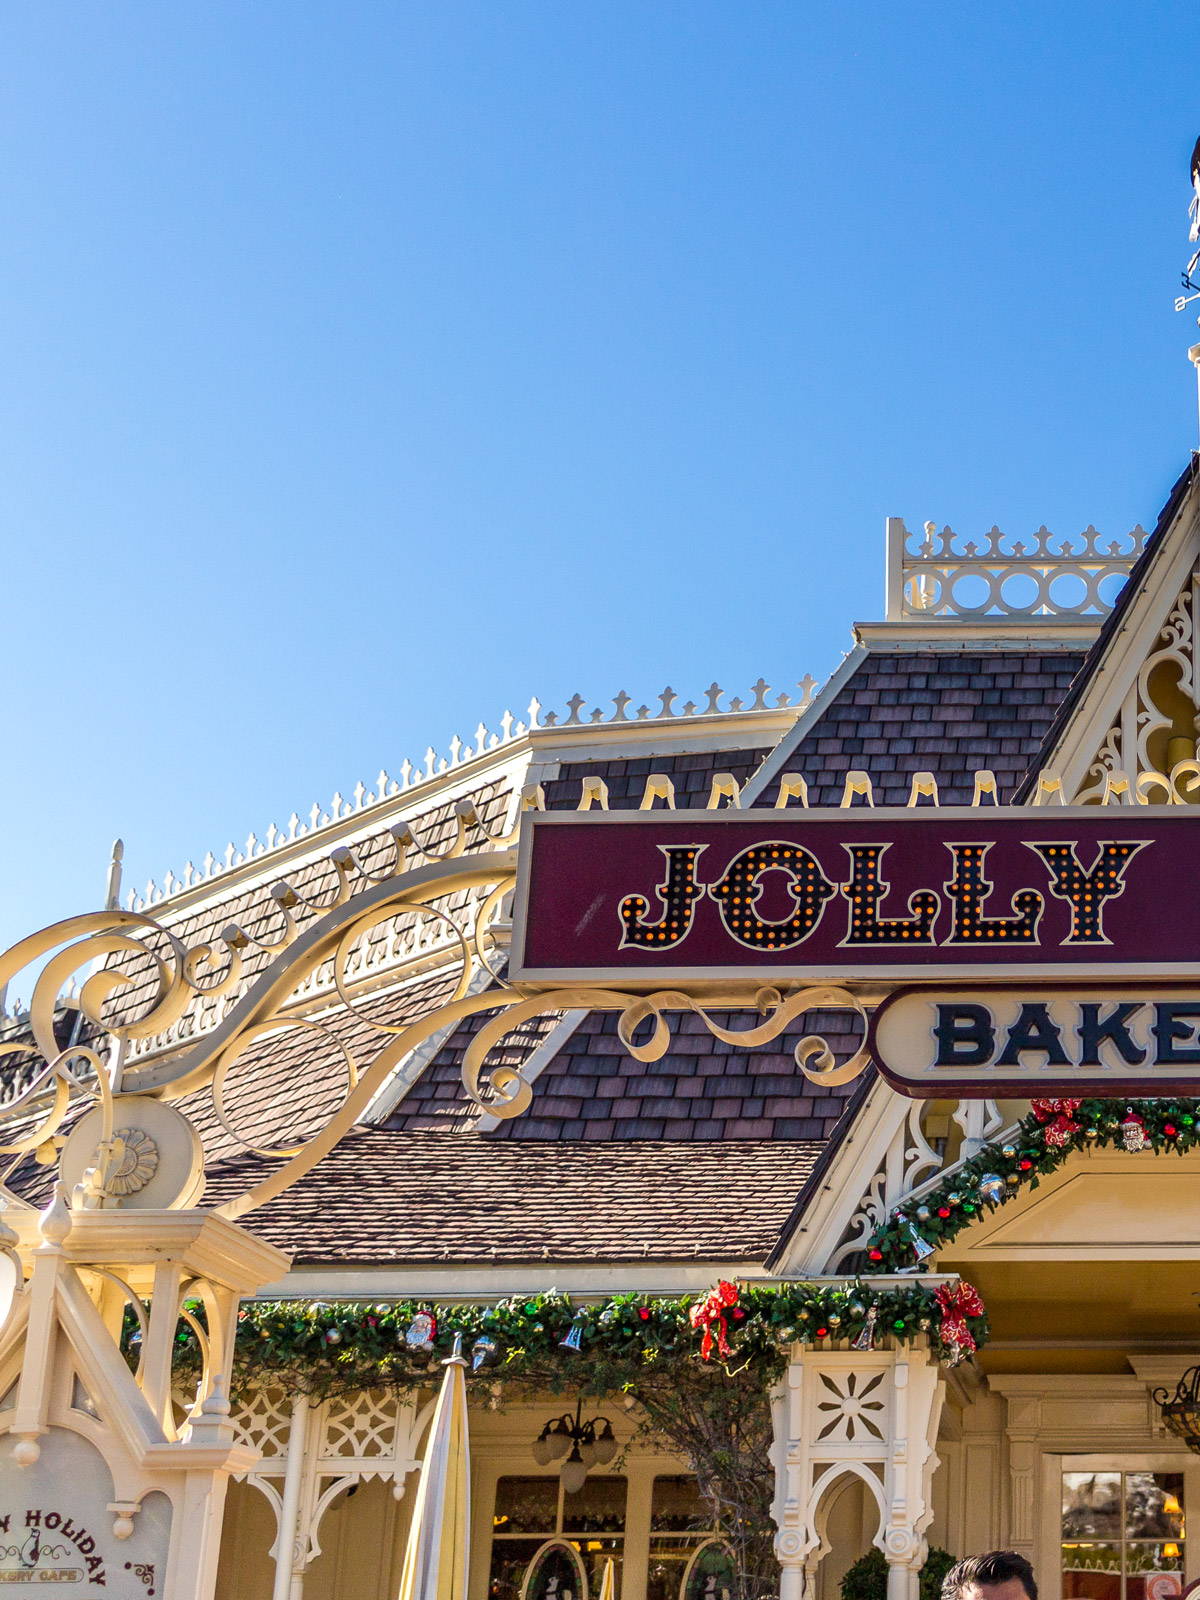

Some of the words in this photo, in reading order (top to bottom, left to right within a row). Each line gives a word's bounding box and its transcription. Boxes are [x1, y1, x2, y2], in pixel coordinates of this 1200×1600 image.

[617, 840, 1155, 951] JOLLY
[25, 1509, 106, 1587] HOLIDAY
[39, 1569, 77, 1581] CAFE
